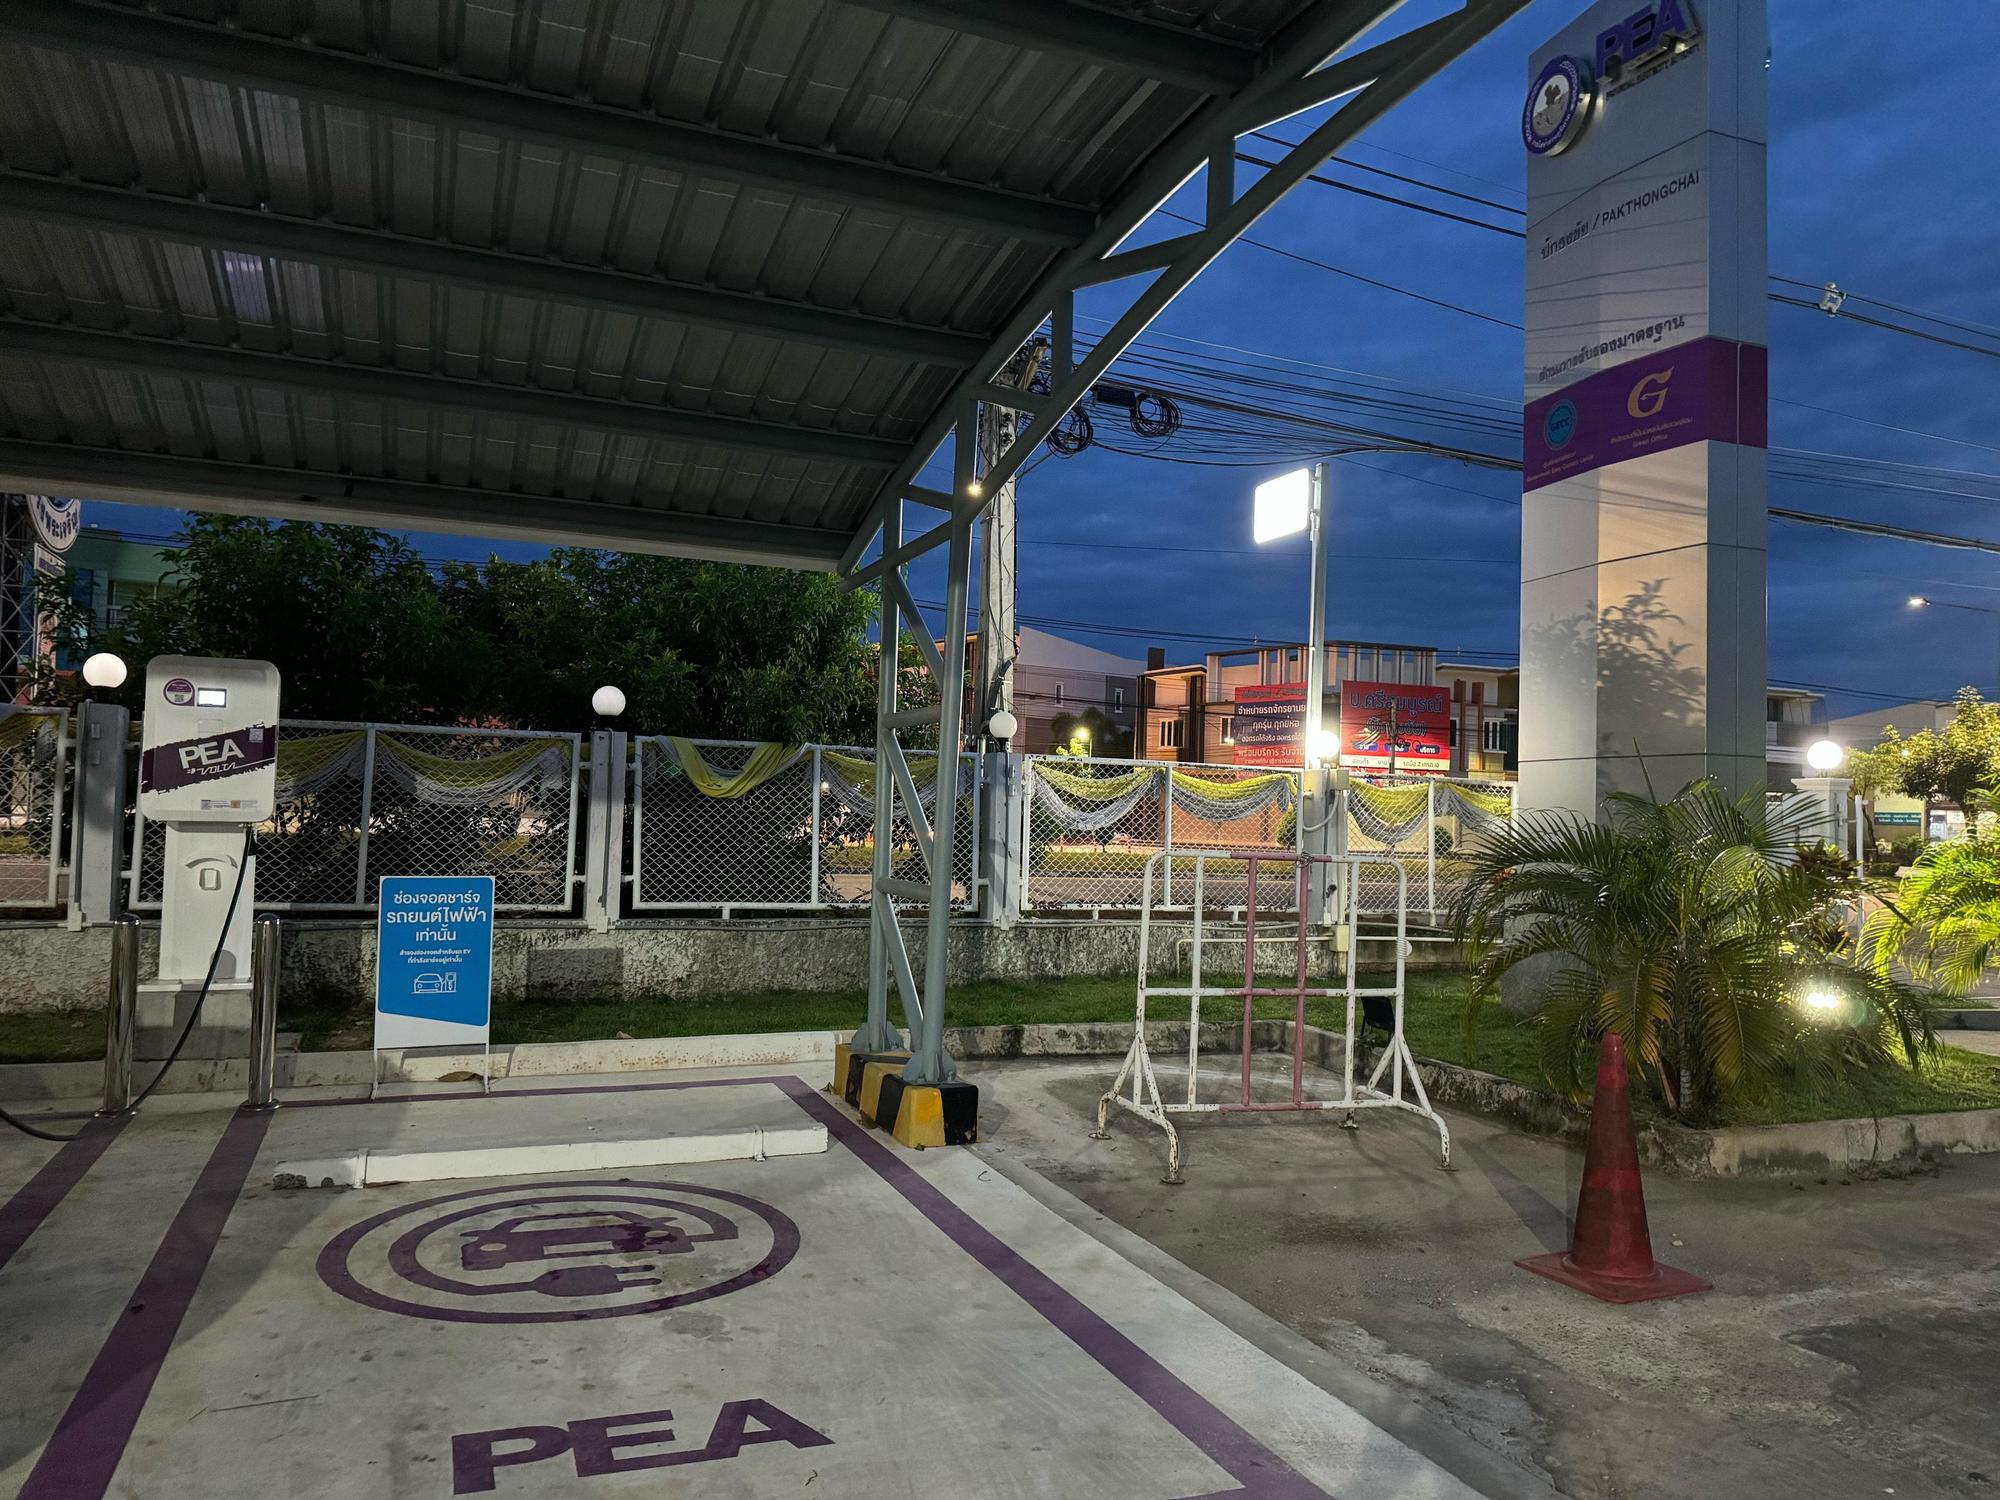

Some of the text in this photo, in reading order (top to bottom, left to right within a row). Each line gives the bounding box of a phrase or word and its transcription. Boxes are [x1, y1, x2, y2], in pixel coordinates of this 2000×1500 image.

[1596, 0, 1690, 82] PEA
[1602, 170, 1700, 225] PAKTHONGCHAI
[1238, 704, 1306, 715] จำหน่ายรถจักรยานย
[178, 738, 245, 769] PEA
[196, 762, 237, 776] VOLTA
[393, 889, 481, 905] ช่องจอดชาร์จ
[386, 906, 487, 925] รถยนต์ไฟฟ้า
[415, 923, 457, 942] เท่านั้น
[452, 1397, 836, 1496] PEA
